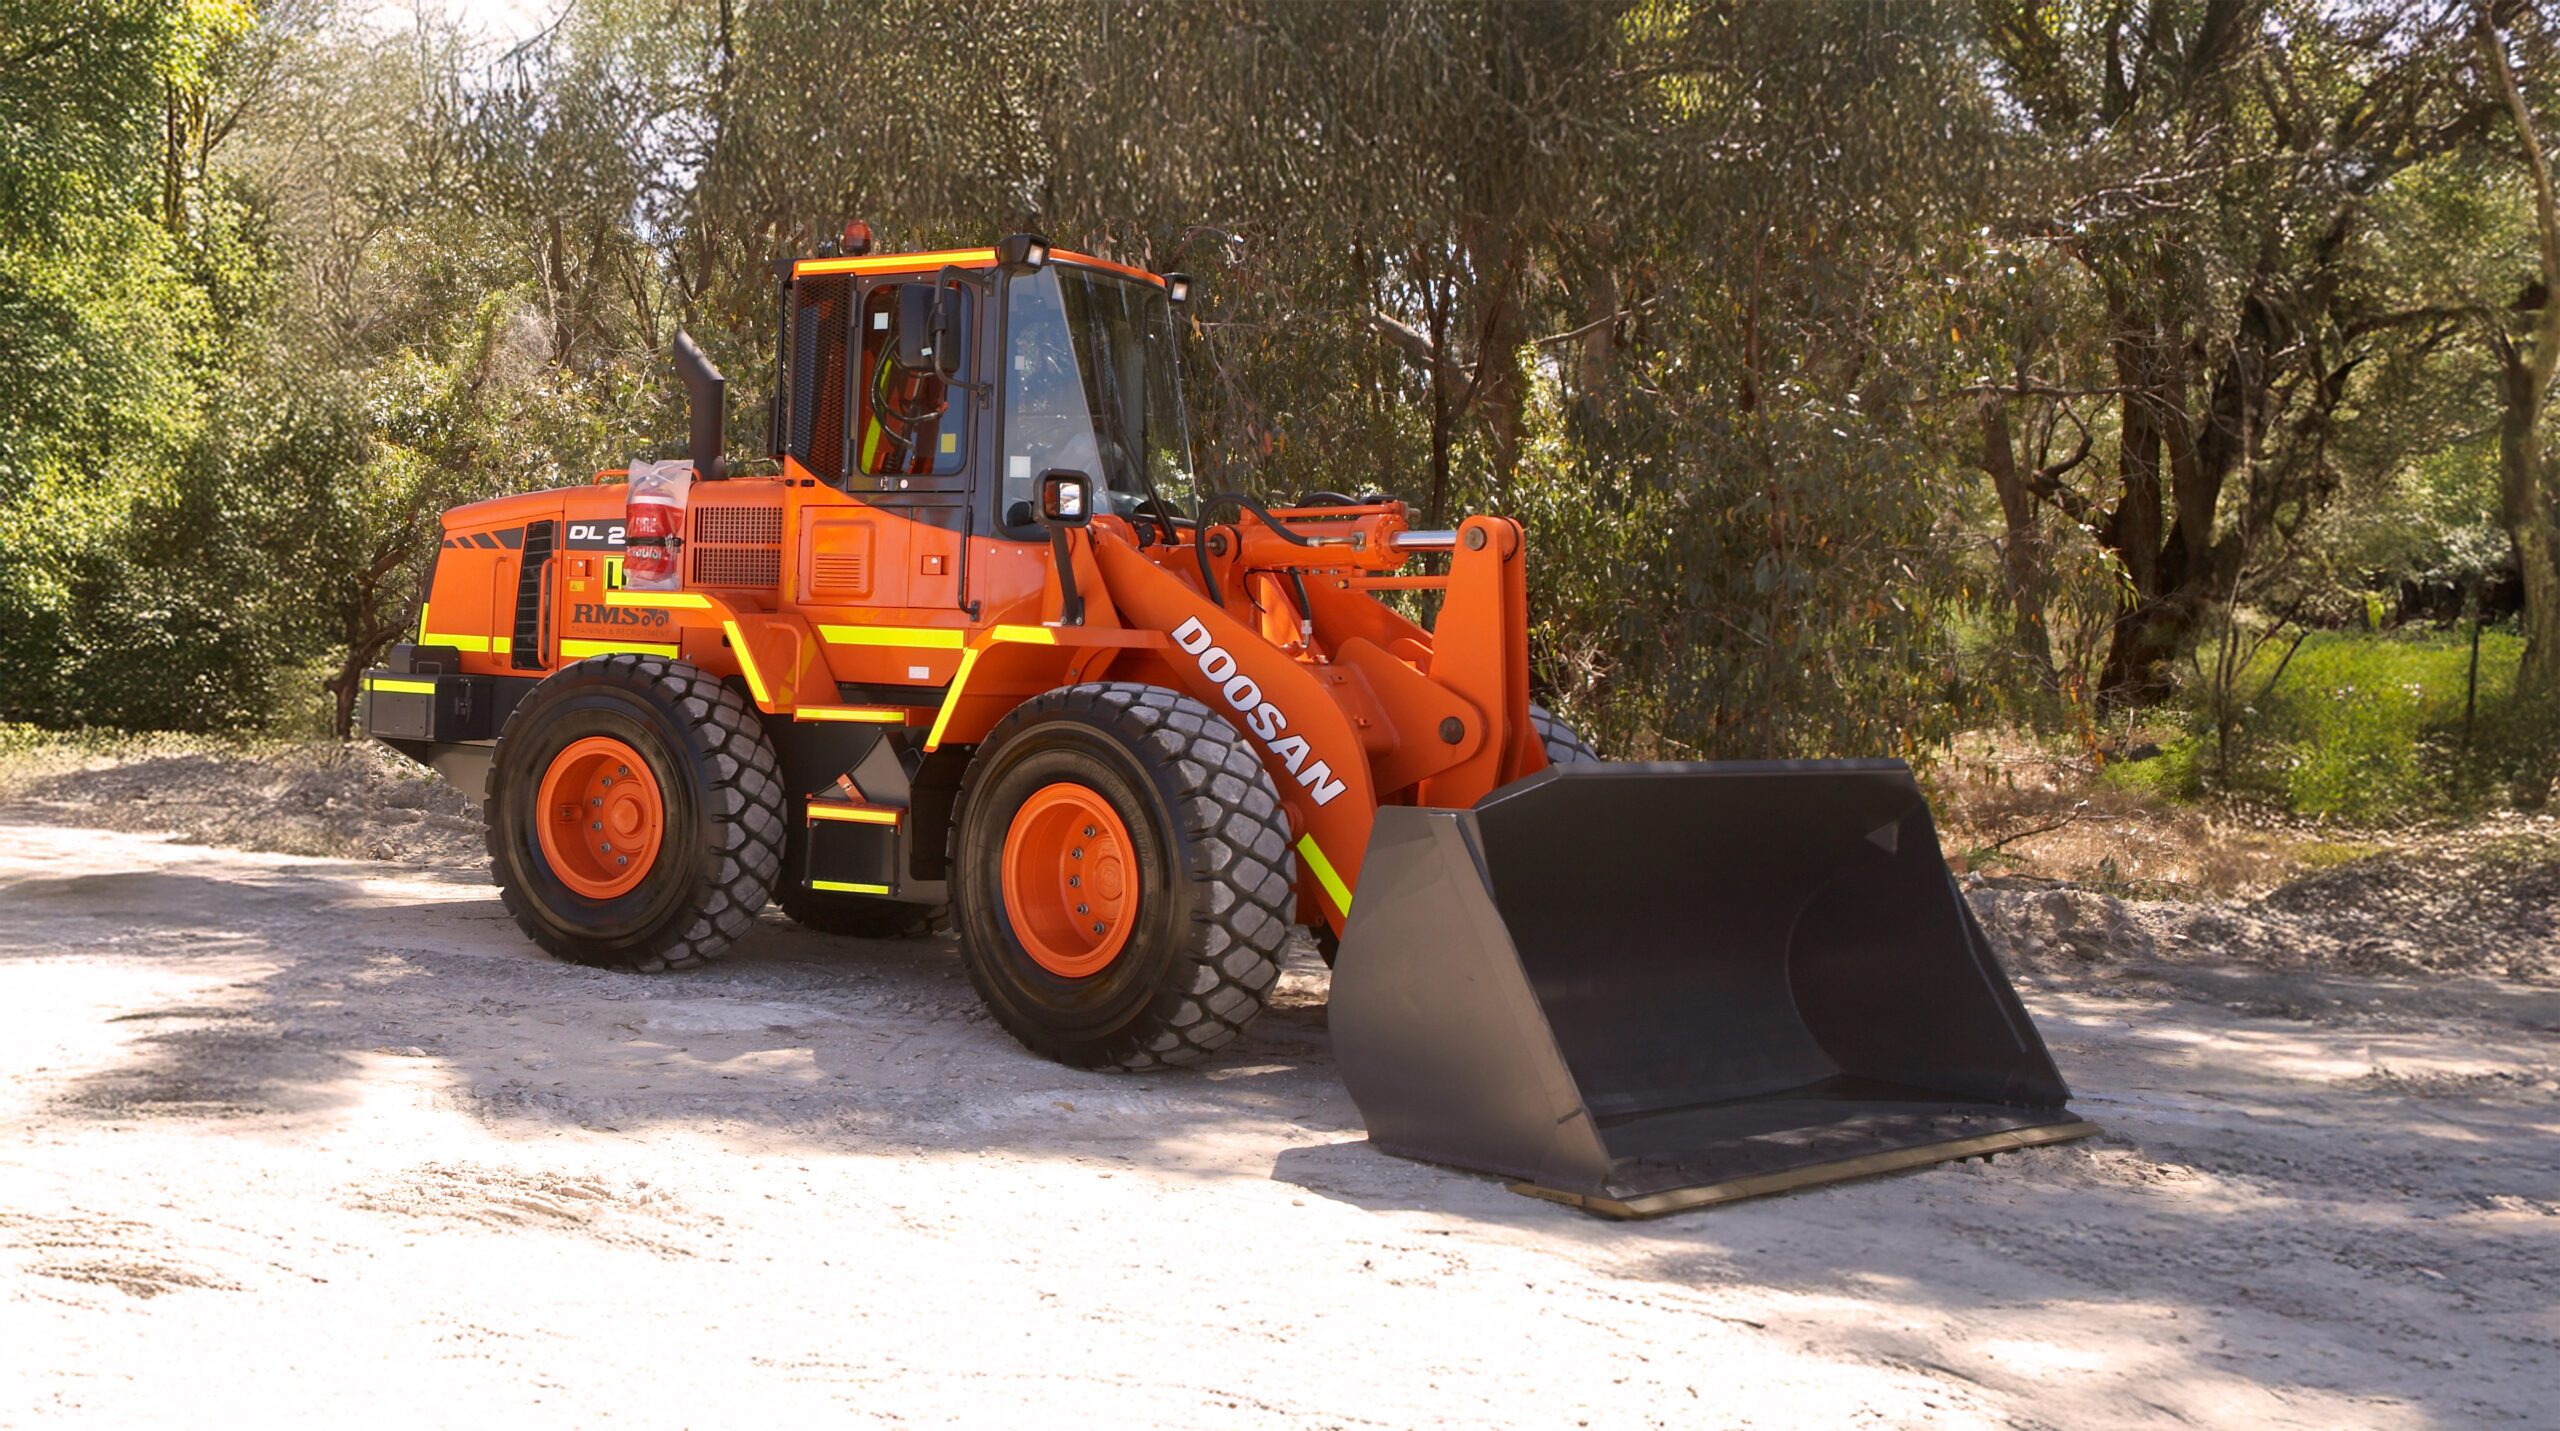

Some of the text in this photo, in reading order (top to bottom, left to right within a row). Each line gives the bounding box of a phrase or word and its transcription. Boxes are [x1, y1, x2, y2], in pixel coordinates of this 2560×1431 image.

[569, 525, 604, 540] DL
[572, 603, 639, 625] RMS
[1171, 615, 1348, 806] DOOSAN
